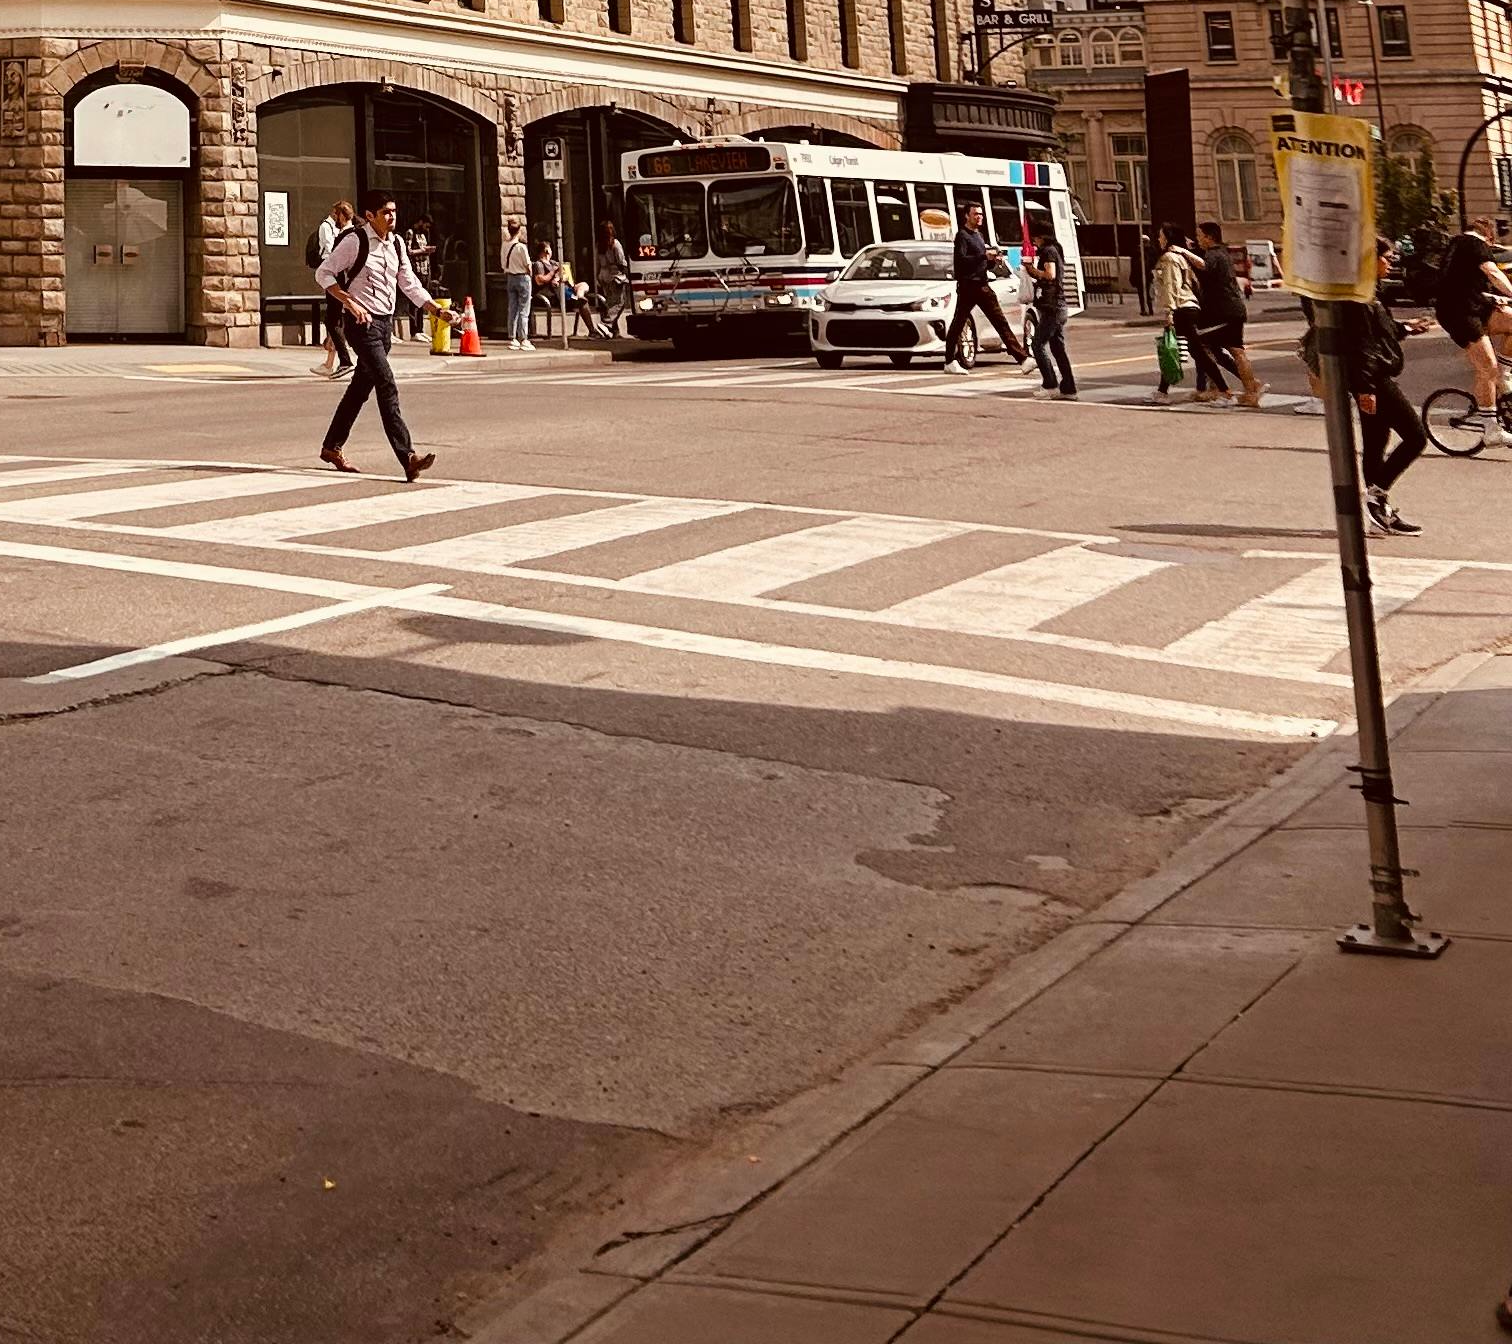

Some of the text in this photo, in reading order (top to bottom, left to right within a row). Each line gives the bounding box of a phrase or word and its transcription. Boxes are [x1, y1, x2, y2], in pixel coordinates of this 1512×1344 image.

[976, 13, 1051, 26] BAR & GRILL
[638, 246, 657, 257] 142
